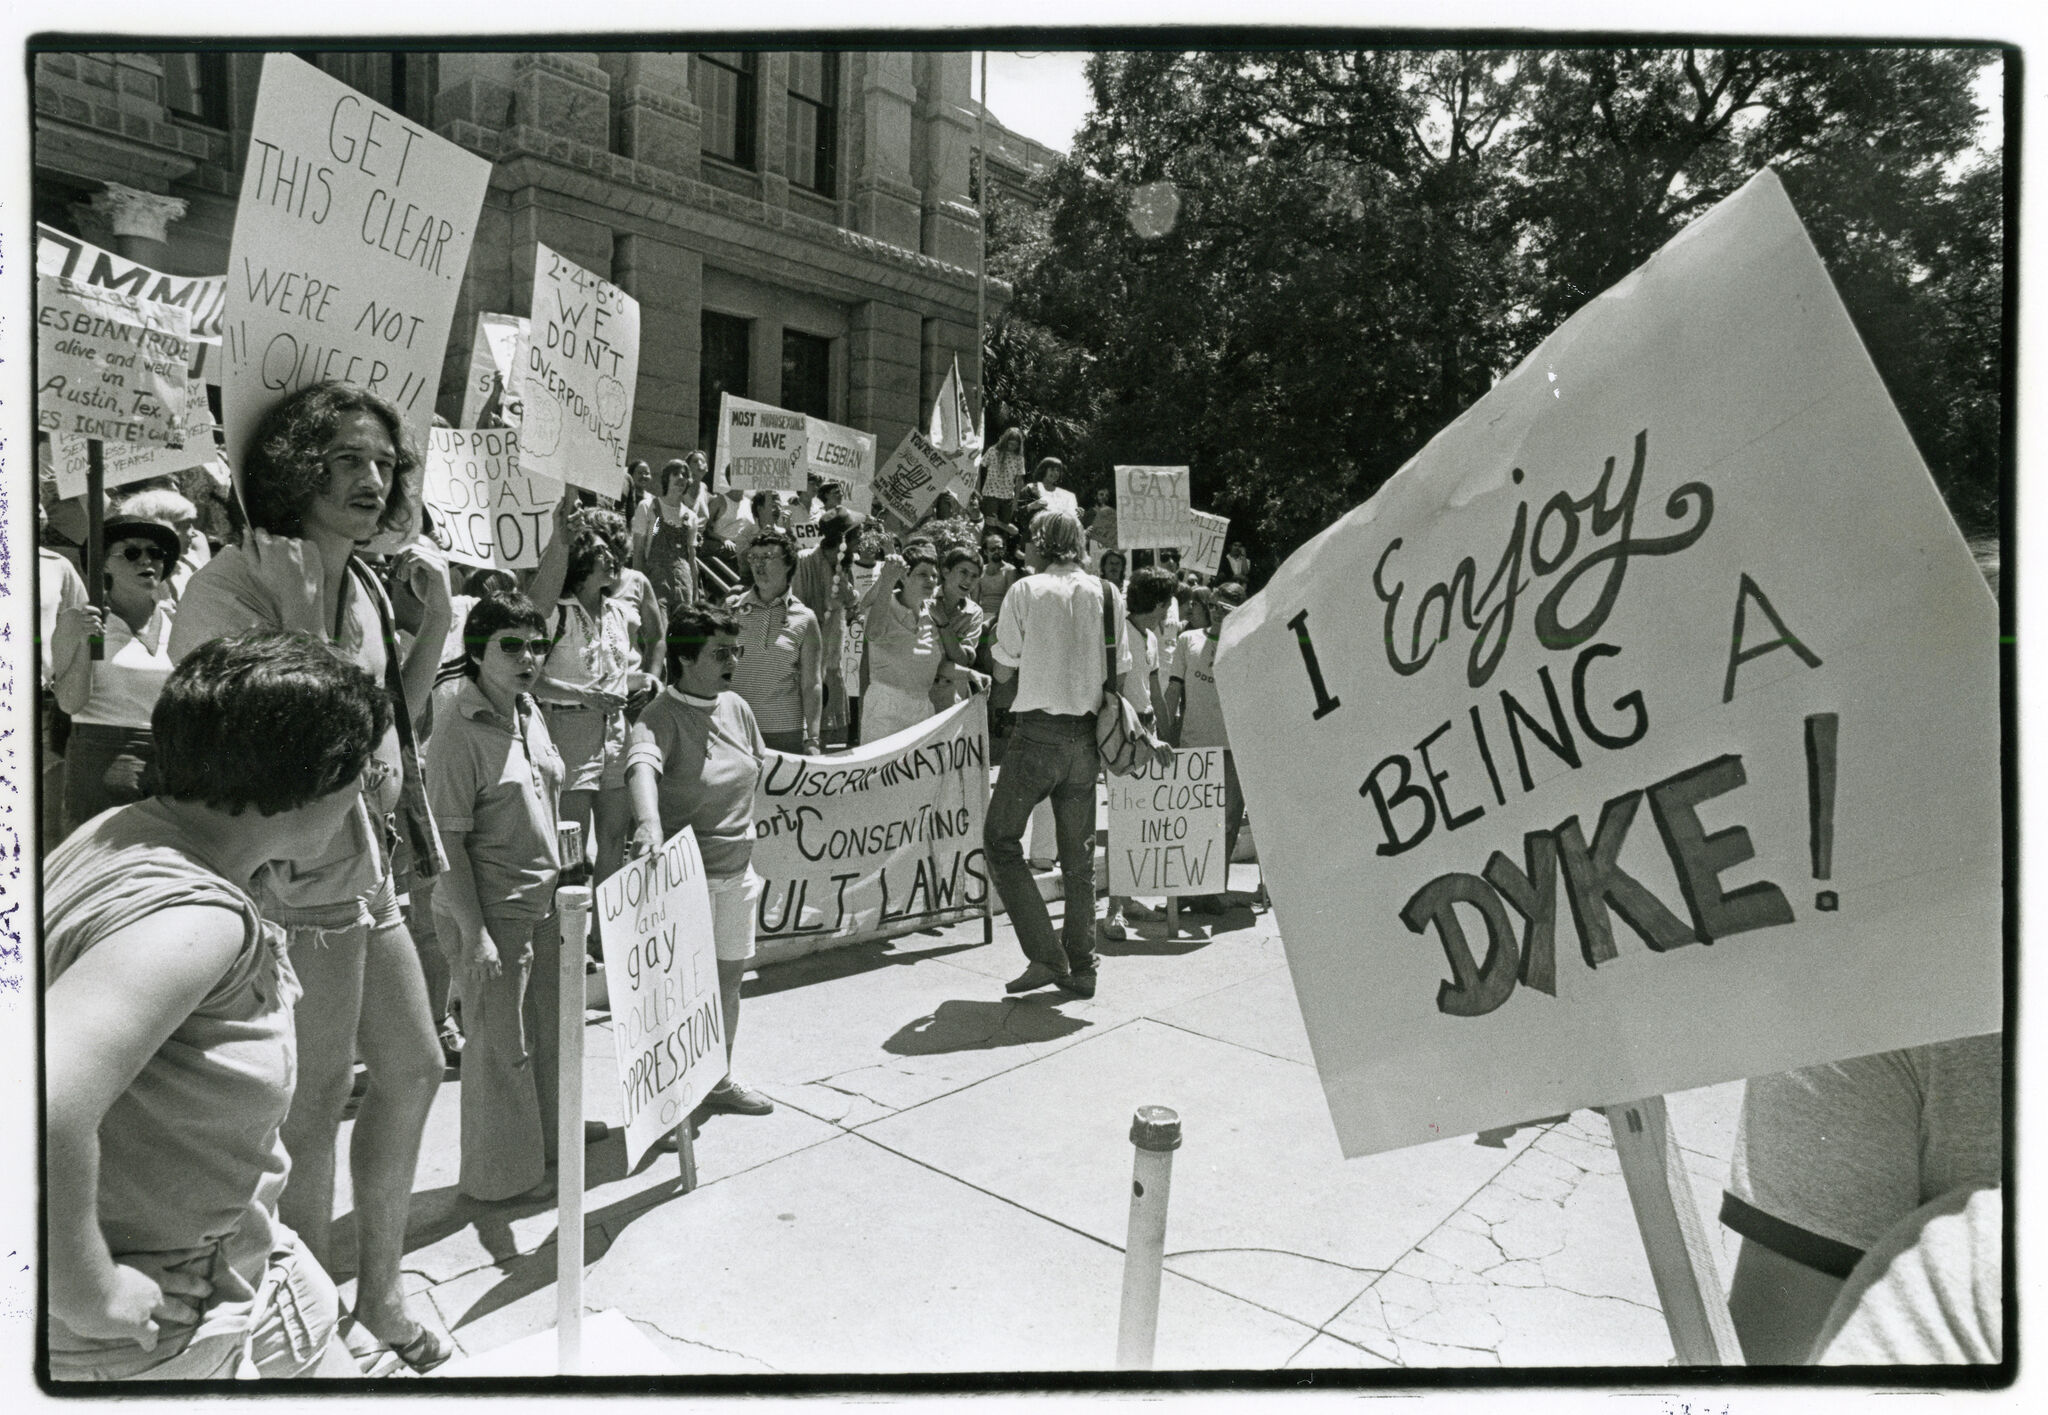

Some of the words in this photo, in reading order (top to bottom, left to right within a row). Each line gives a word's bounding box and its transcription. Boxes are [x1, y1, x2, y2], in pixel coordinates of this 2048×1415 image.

[329, 95, 424, 187] GET
[254, 137, 334, 225] THIS
[37, 305, 132, 343] ESBIAN
[244, 256, 341, 323] WE'RE
[354, 300, 425, 350] NOT
[556, 287, 612, 347] WE
[54, 337, 98, 361] alive
[105, 351, 137, 369] and
[143, 360, 174, 379] well
[547, 320, 625, 378] DON'T
[38, 374, 126, 418] Austin,
[132, 388, 162, 420] Tex.
[102, 370, 125, 388] in
[38, 409, 63, 431] ES
[530, 345, 626, 469] OVERPOPULATE
[731, 411, 756, 427] MOST
[428, 431, 520, 456] UPPOR
[752, 432, 786, 450] HAVE
[816, 440, 863, 469] LESBIAN
[927, 451, 946, 470] OFF
[443, 455, 522, 480] YOUR
[1128, 469, 1183, 498] GAY
[429, 477, 556, 509] LOCAL
[1119, 496, 1188, 523] PRIDE
[427, 501, 549, 562] BIGOT
[1189, 514, 1227, 533] ALIZE
[1287, 609, 1341, 720] I
[1372, 428, 1715, 690] Enjoy
[1358, 643, 1650, 858] BEING
[1722, 571, 1824, 704] A
[1187, 751, 1217, 782] OF
[1110, 787, 1147, 812] the
[797, 803, 970, 862] CONSENTING
[1127, 839, 1213, 889] VIEW
[758, 872, 861, 934] ULT
[878, 848, 989, 918] LAWS
[638, 901, 667, 935] and
[627, 922, 677, 992] gay
[617, 950, 706, 1062] DOUBLE
[622, 992, 720, 1129] OPPRESSION
